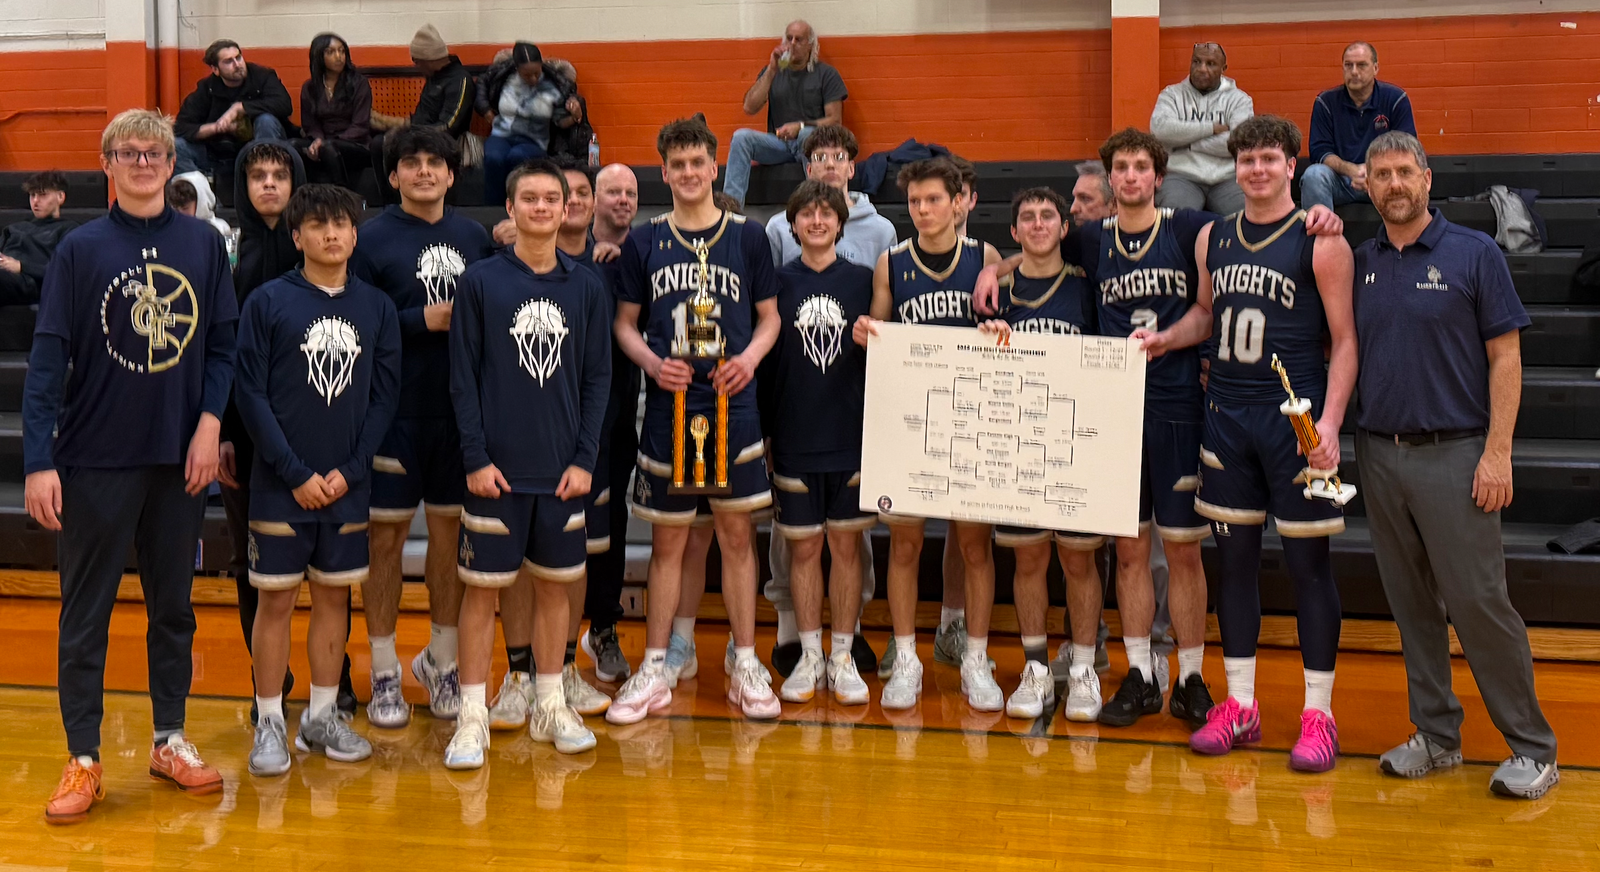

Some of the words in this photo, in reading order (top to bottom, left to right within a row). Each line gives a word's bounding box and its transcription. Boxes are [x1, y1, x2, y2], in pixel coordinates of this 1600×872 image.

[651, 262, 740, 302] KNIGHTS
[1100, 268, 1188, 305] KNIGHTS
[898, 290, 978, 325] KNIGHT
[1218, 306, 1266, 364] 10
